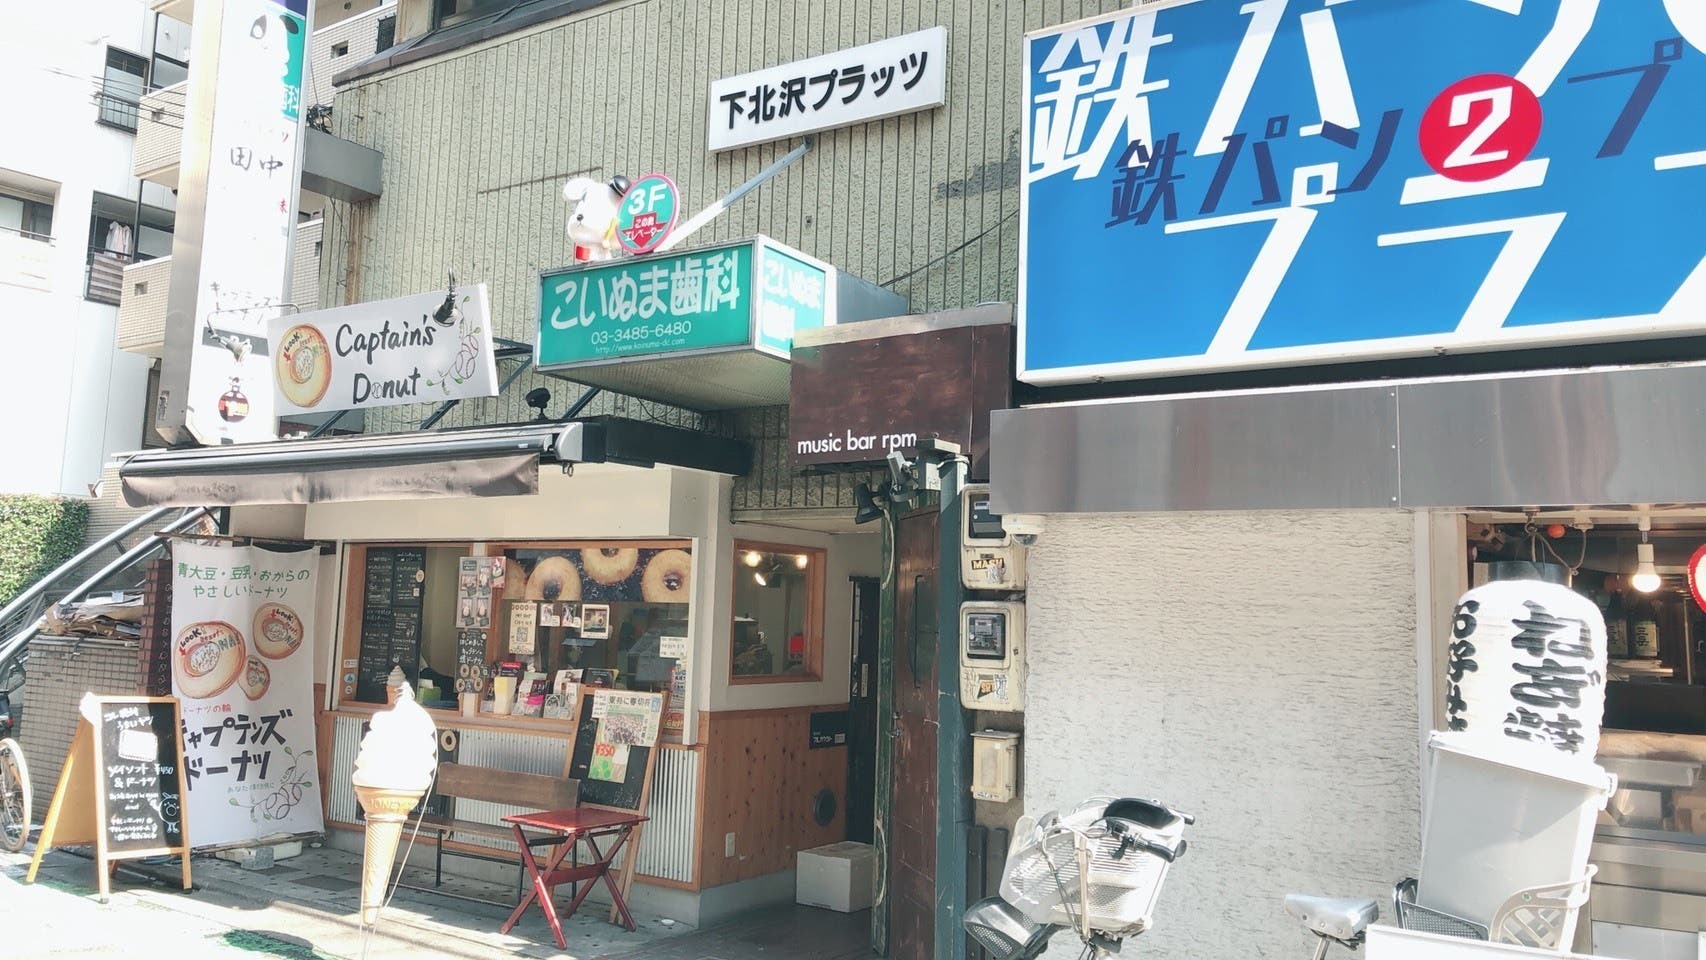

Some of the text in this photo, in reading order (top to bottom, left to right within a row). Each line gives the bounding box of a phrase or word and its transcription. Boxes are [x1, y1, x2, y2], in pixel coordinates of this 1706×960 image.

[719, 50, 929, 129] 下北沢プラッツ
[1105, 108, 1404, 229] 鉄パン
[1443, 86, 1513, 168] 2
[628, 184, 667, 215] 3F
[625, 227, 663, 242] エレベーター
[551, 250, 740, 330] こいぬま歯科
[335, 314, 437, 364] Captain's
[591, 320, 692, 345] 03-3485-6480
[797, 429, 917, 454] music bar rpm
[183, 750, 271, 791] ドーナツ
